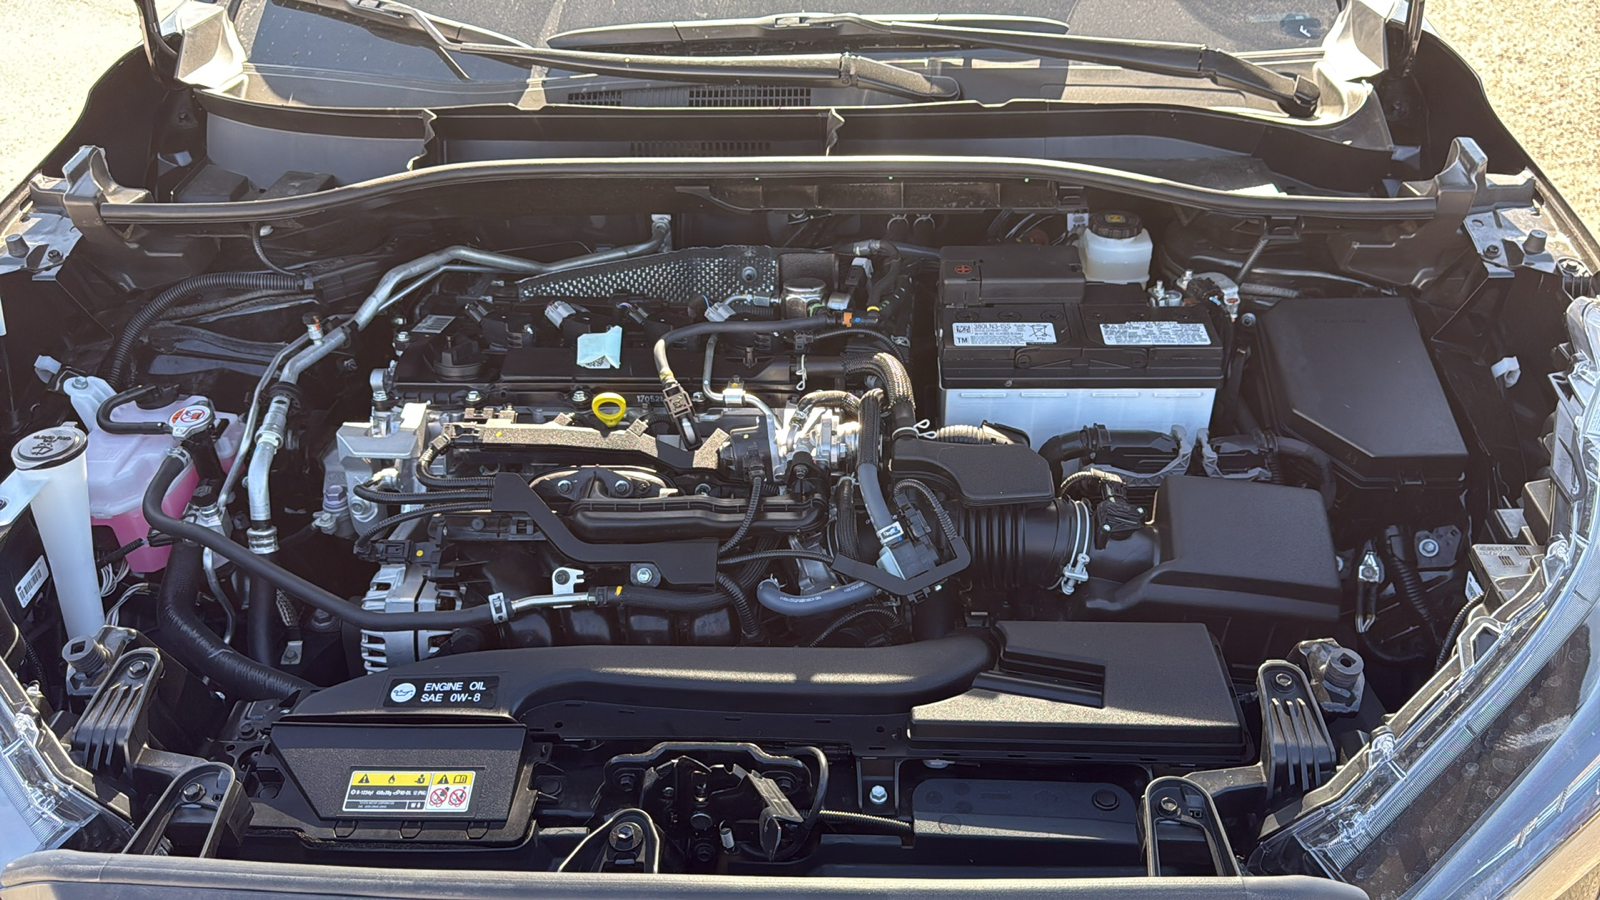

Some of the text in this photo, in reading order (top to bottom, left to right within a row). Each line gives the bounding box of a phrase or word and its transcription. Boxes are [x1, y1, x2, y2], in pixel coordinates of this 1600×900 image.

[424, 681, 486, 691] ENGINE OIL
[420, 693, 443, 702] SAE
